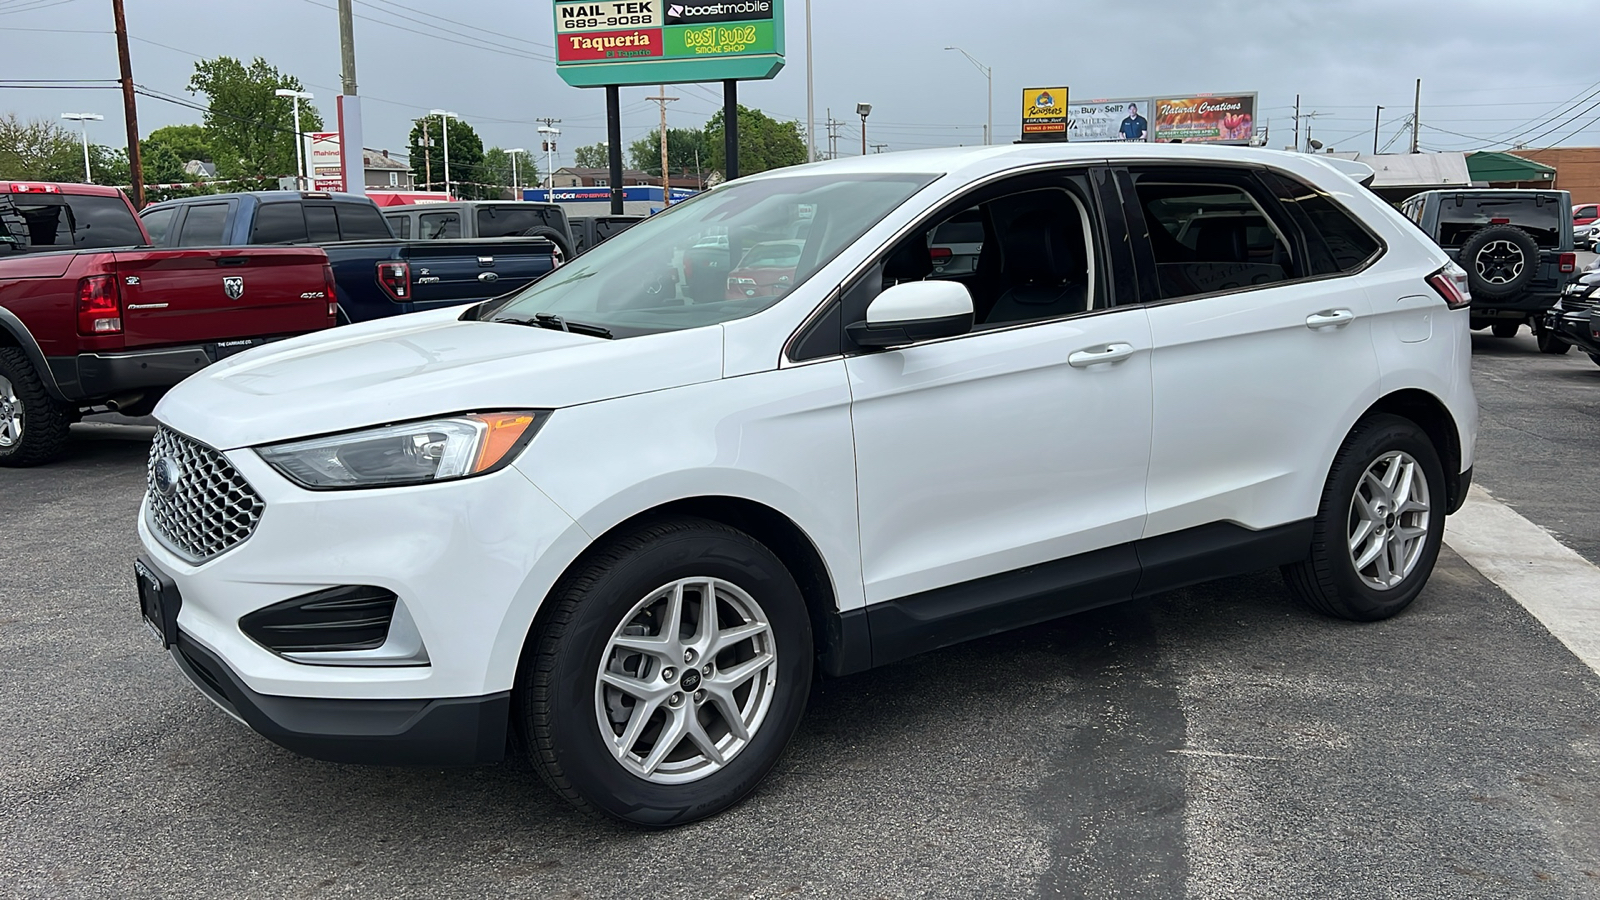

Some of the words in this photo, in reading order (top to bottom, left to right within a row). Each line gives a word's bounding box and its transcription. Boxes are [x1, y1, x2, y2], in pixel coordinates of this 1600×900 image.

[562, 5, 605, 18] NAIL
[613, 2, 652, 14] TEK
[565, 15, 652, 28] 689-9088
[718, 25, 756, 45] BUDZ
[695, 45, 722, 54] SMOKE
[724, 44, 745, 52] SHOP
[1028, 106, 1062, 117] Roosters
[1160, 104, 1197, 115] Natural
[1198, 102, 1241, 114] Creations
